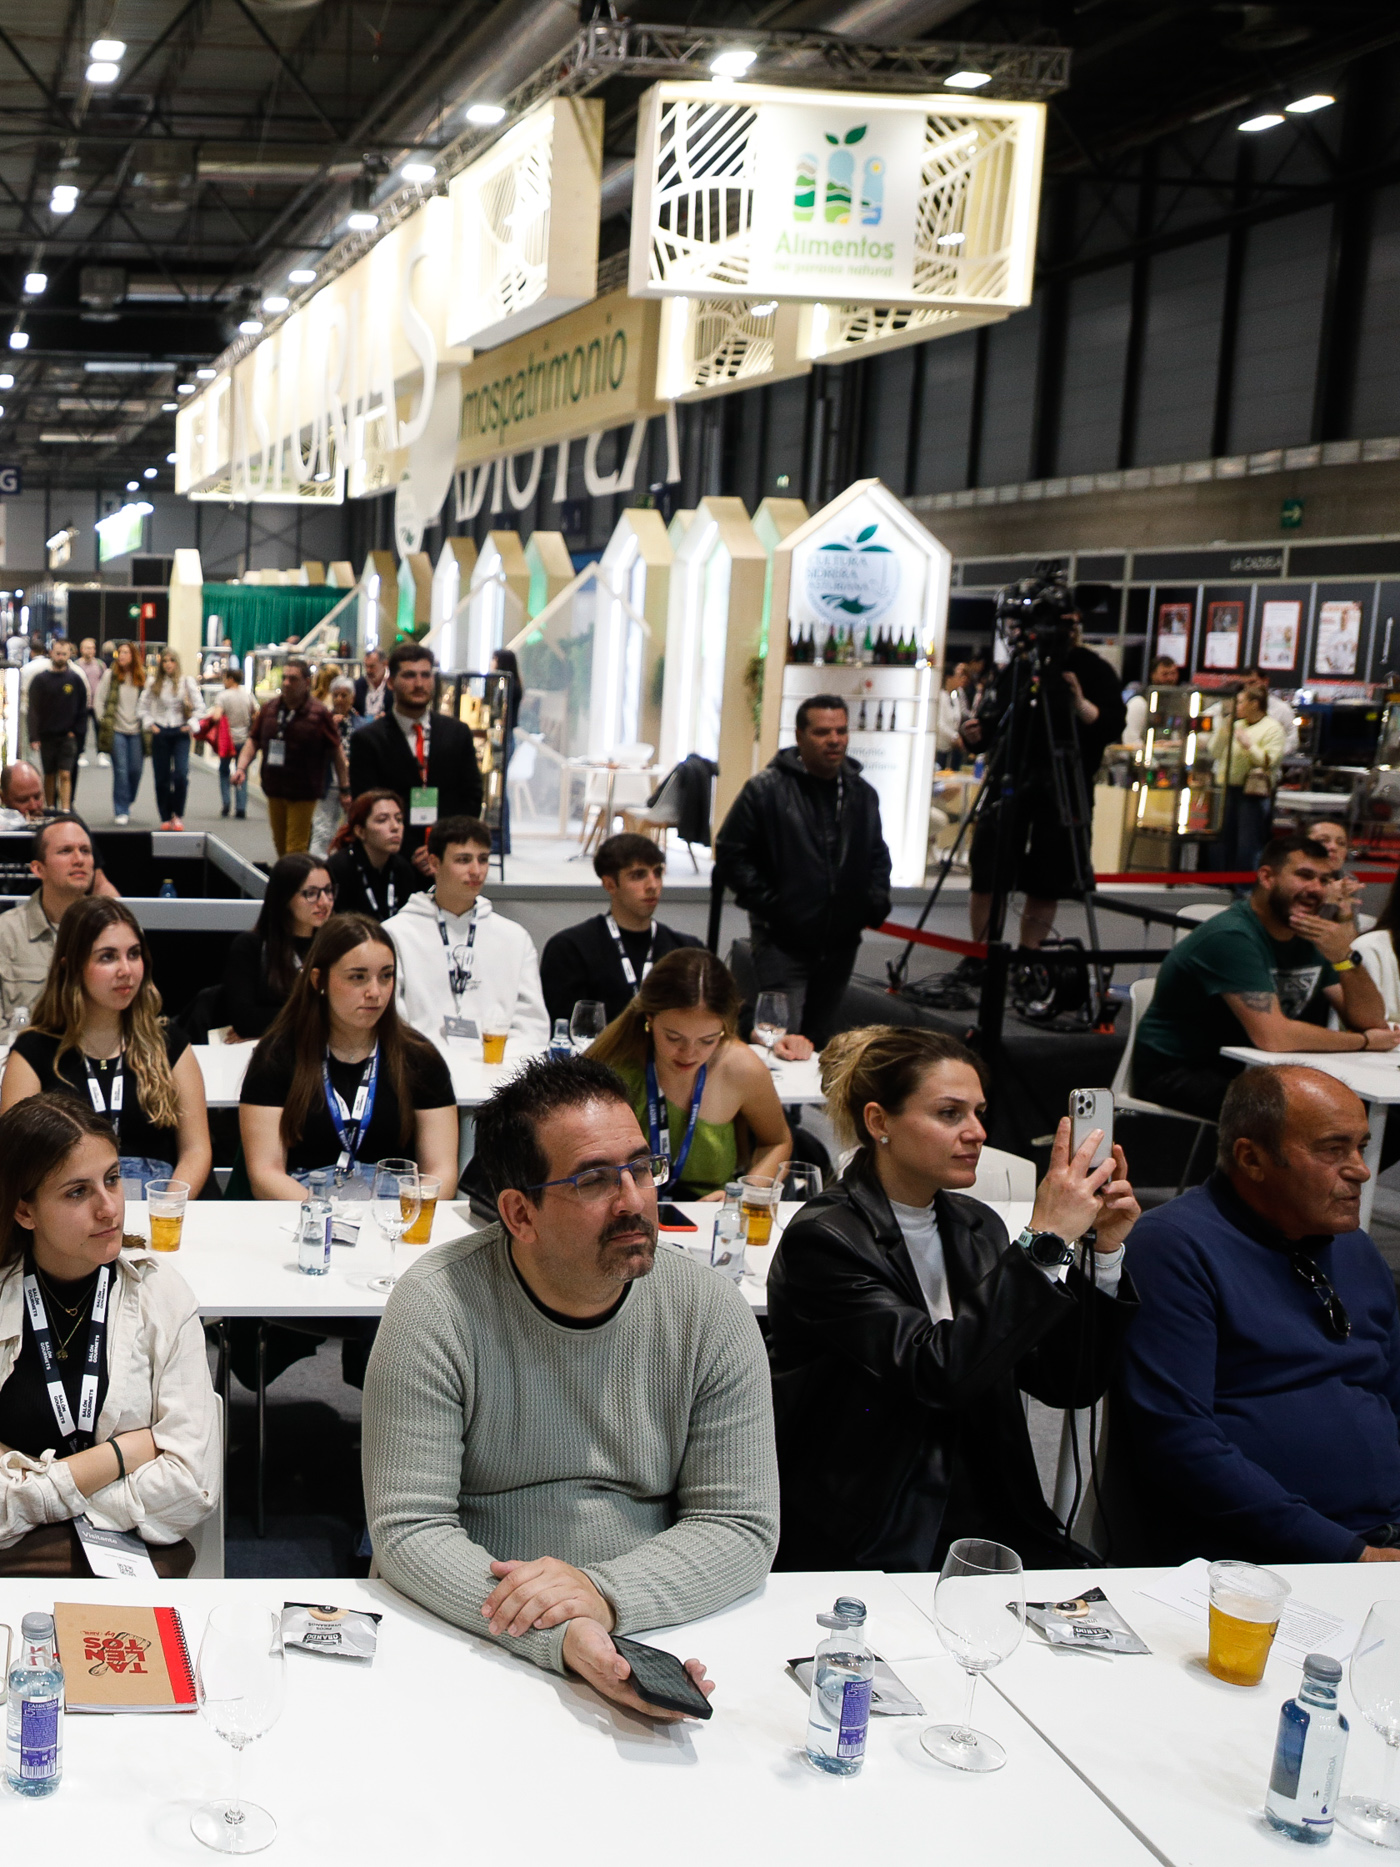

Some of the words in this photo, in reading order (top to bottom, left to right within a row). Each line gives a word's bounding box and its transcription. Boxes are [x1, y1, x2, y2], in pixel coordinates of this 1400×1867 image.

[775, 230, 895, 260] Alimentos
[27, 1289, 38, 1317] GOURMETS
[32, 1287, 40, 1306] SALÓN
[40, 1341, 51, 1370] GOURMETS
[53, 1395, 65, 1424] GOURMETS
[59, 1394, 67, 1412] SALÓN
[82, 1531, 118, 1545] Visitante
[83, 1637, 143, 1650] TOS
[306, 1633, 339, 1641] OBANDO
[84, 1649, 146, 1662] LEN
[106, 1661, 149, 1674] TA
